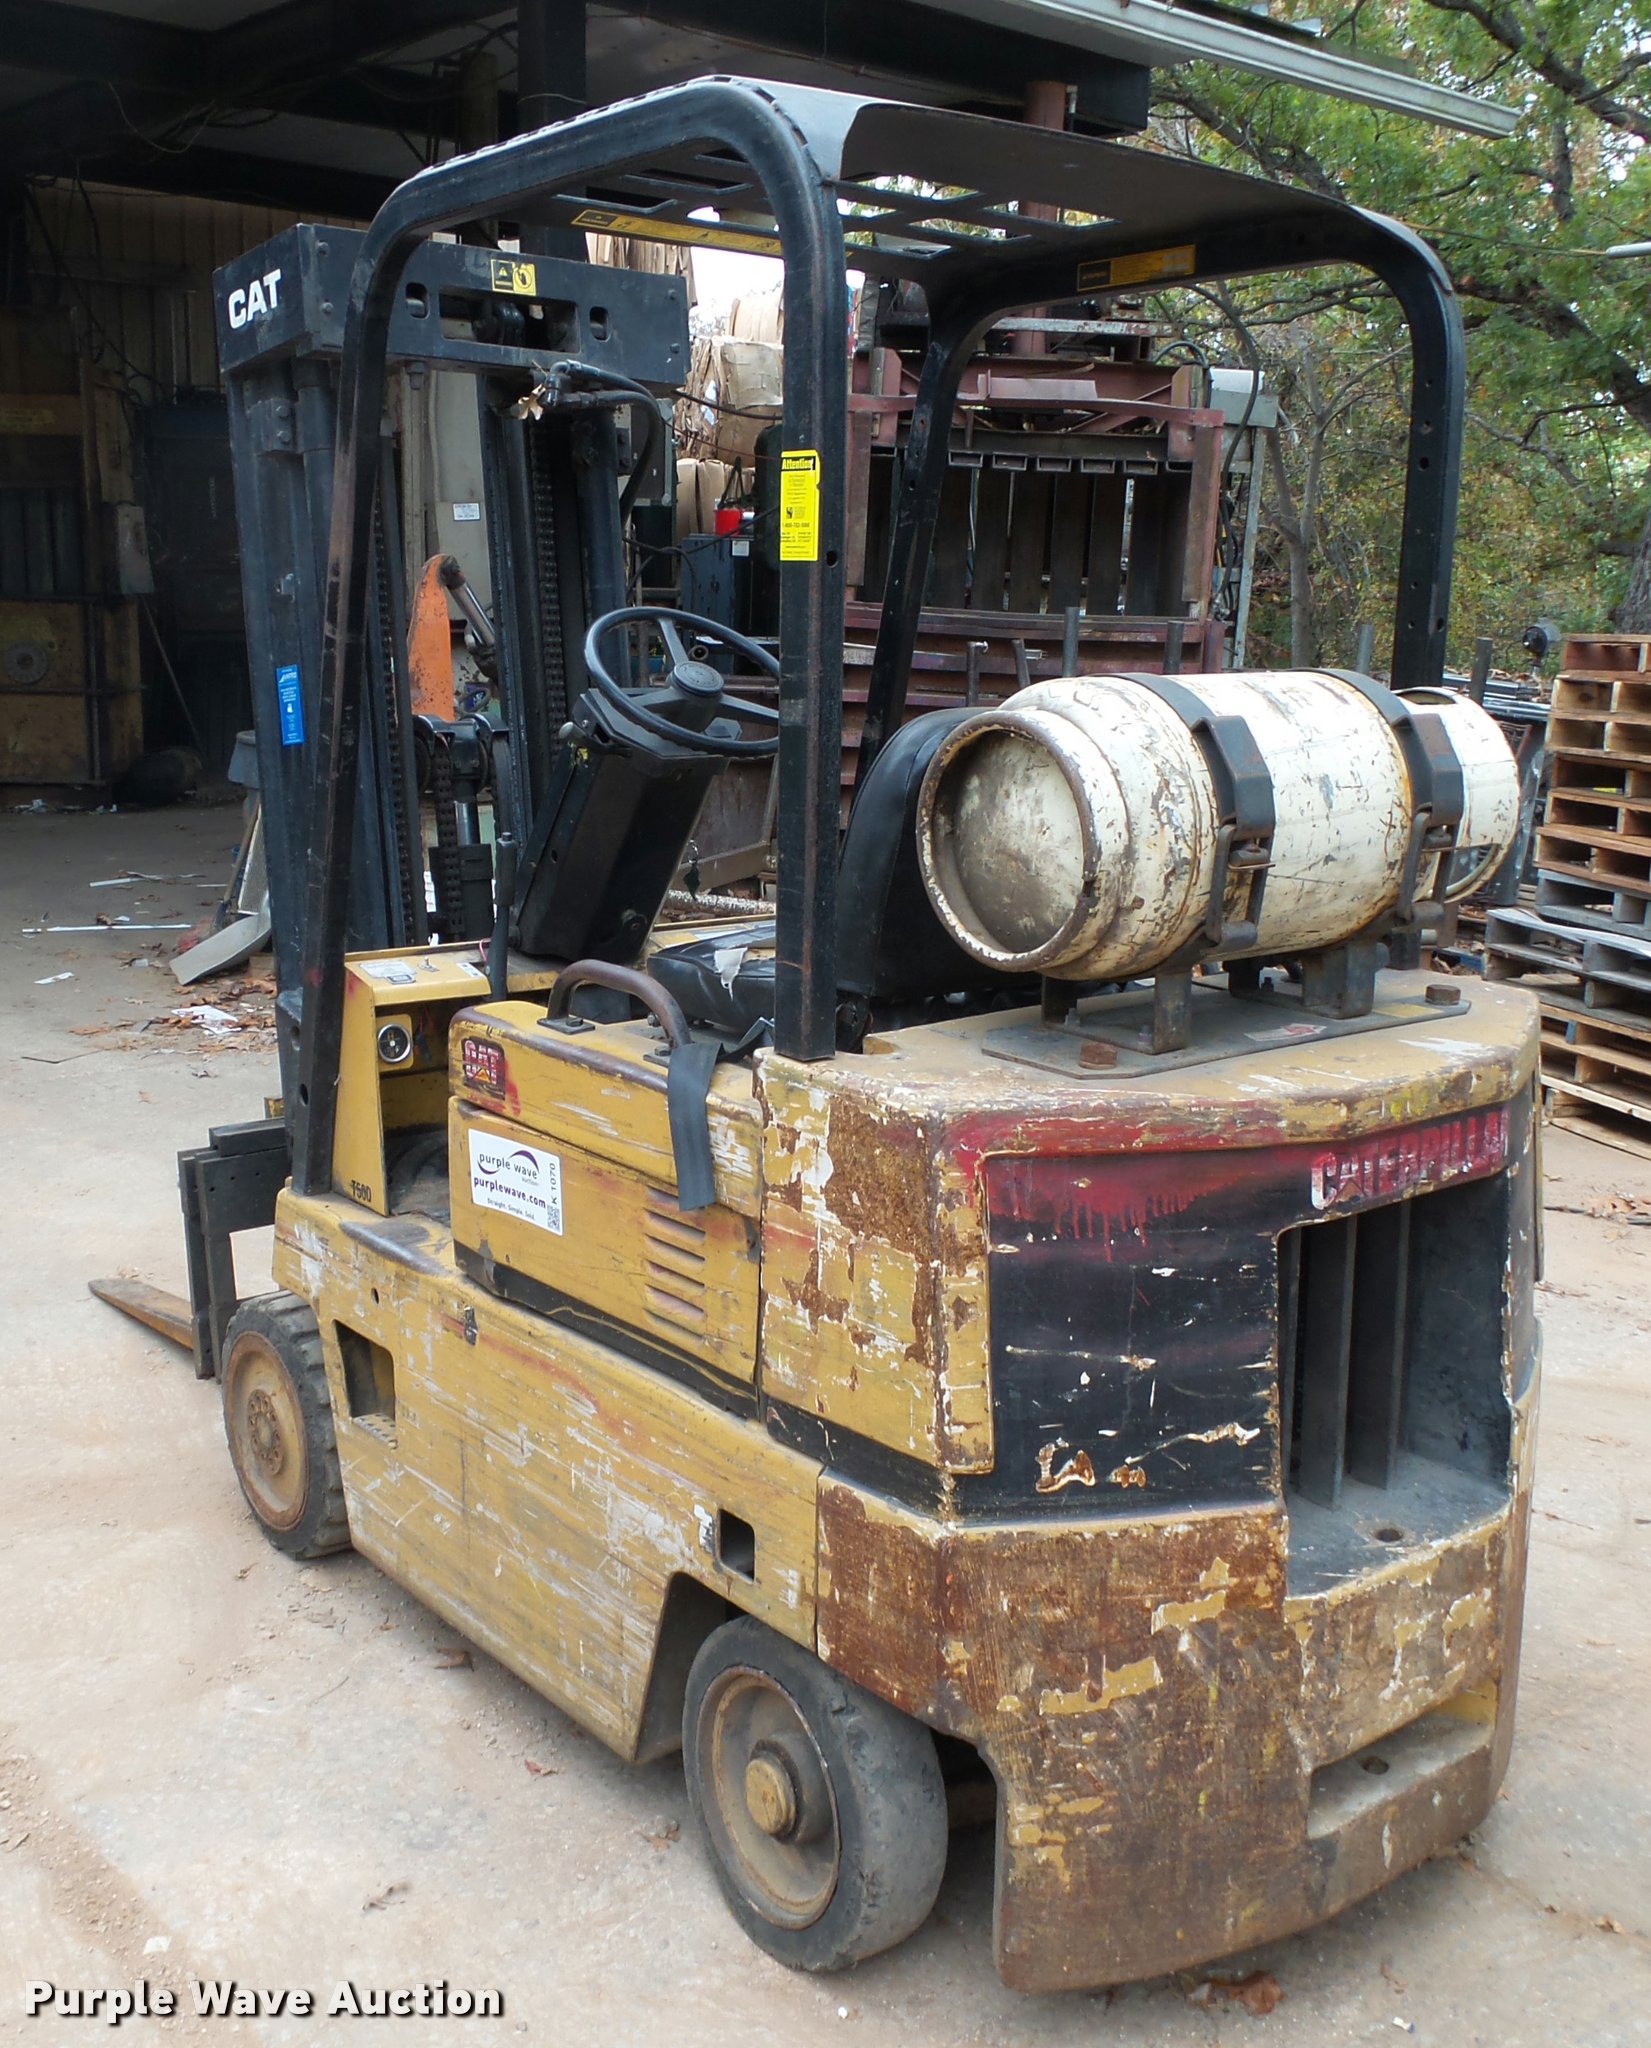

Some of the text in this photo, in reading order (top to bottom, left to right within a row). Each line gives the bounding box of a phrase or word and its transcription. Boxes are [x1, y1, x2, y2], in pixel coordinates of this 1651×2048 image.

[228, 268, 281, 329] CAT
[479, 1153, 538, 1180] purple wave
[549, 1162, 557, 1191] 1070
[473, 1177, 547, 1209] purplewave.com
